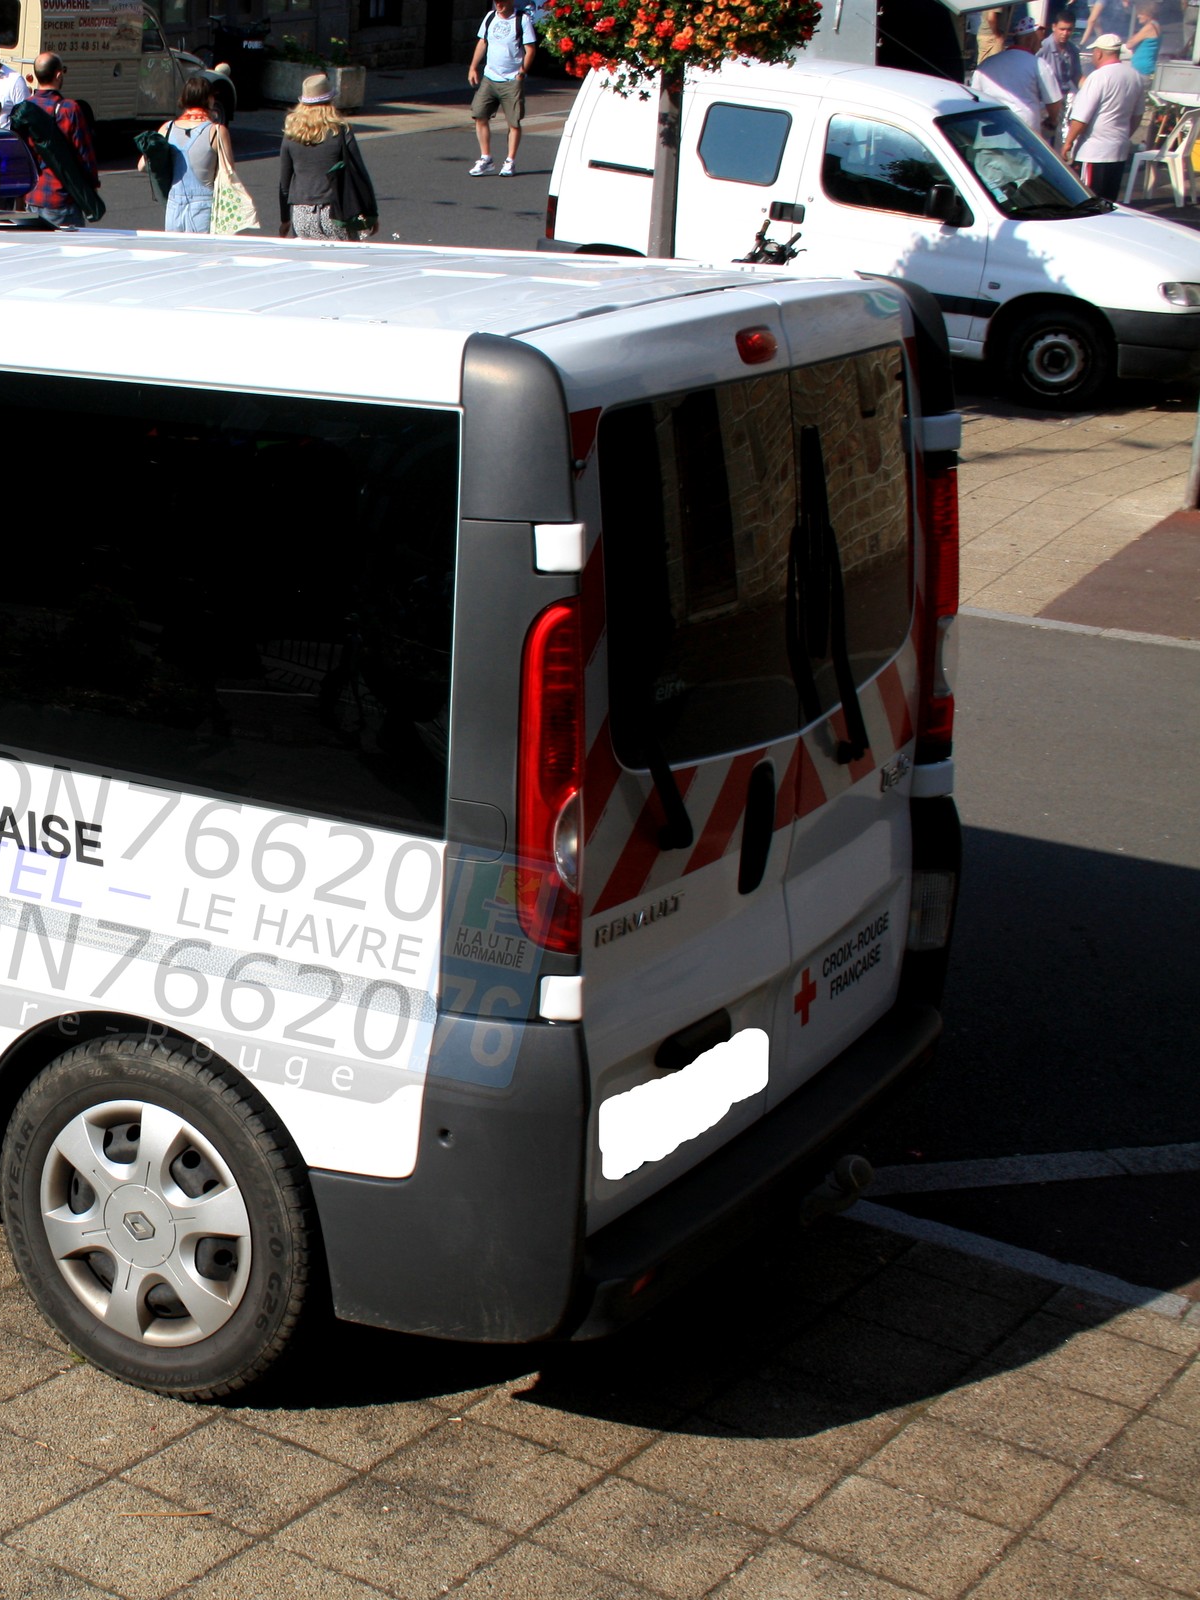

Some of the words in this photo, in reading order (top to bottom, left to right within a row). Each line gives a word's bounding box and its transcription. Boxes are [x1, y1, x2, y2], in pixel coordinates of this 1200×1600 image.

[43, 20, 75, 30] EPICERIE
[57, 41, 68, 50] 02
[594, 889, 685, 948] RENAULT
[822, 911, 889, 978] CROIX-ROUGE
[829, 943, 881, 1000] FRANÇAISE
